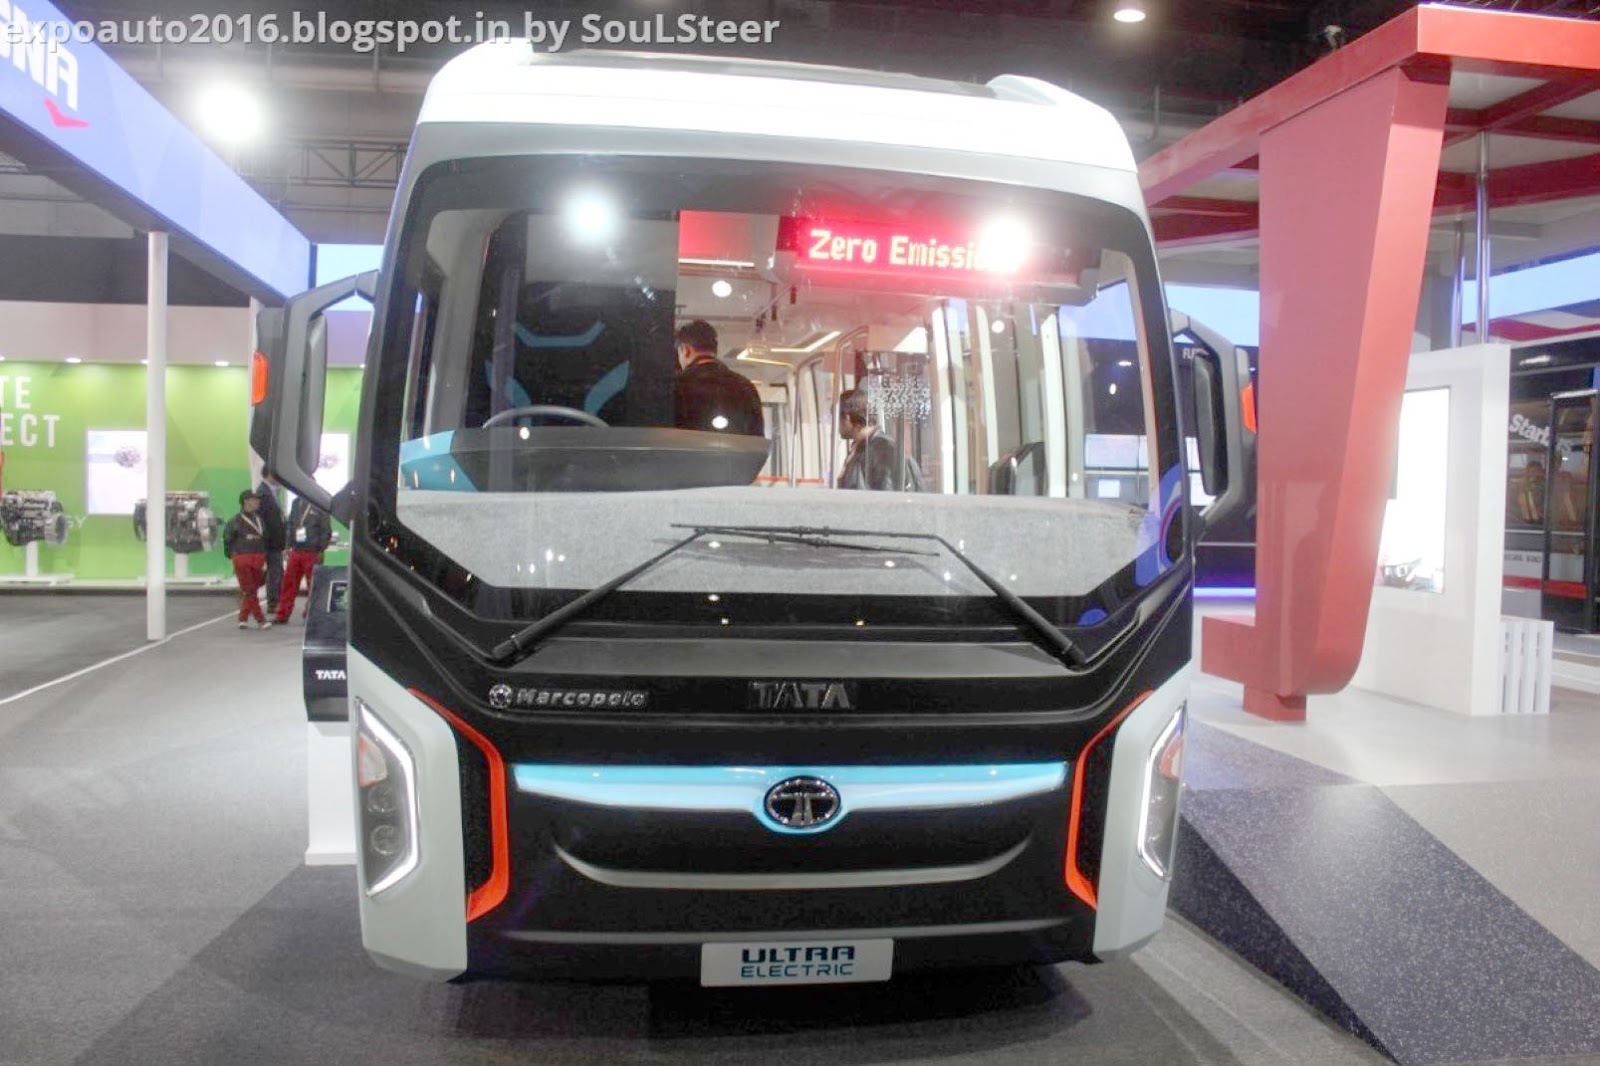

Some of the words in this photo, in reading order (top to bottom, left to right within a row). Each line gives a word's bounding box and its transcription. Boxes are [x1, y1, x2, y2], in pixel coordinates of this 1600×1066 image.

[809, 228, 877, 263] Zero
[888, 234, 985, 271] Emissi
[315, 669, 347, 680] TATA
[516, 688, 647, 708] Marcopolo
[753, 682, 851, 709] TATA
[741, 945, 855, 963] ULTRA
[740, 962, 854, 978] ELECTRIC
